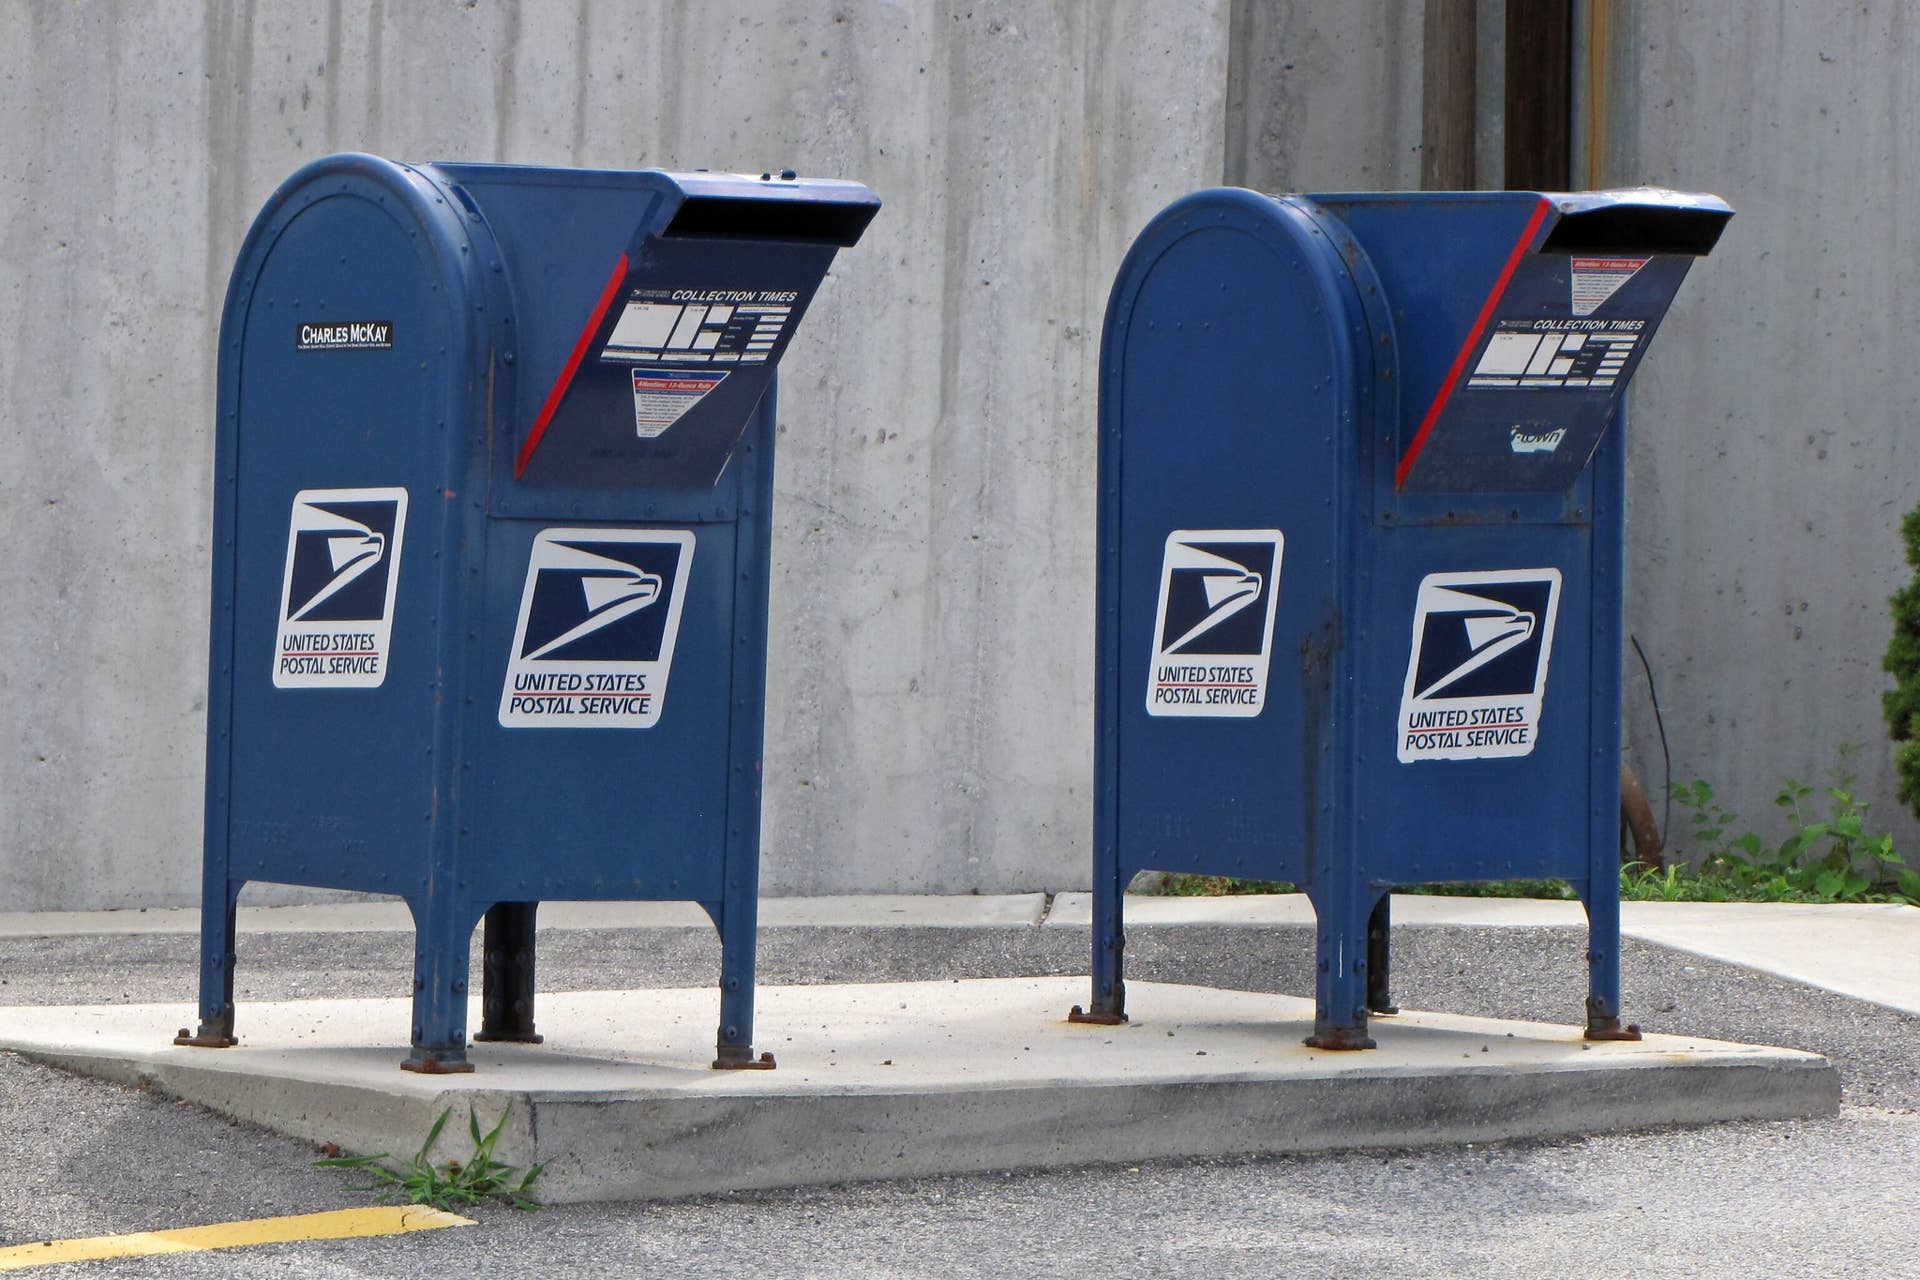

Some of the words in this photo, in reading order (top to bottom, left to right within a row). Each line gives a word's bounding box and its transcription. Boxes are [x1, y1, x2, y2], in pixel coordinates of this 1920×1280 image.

[671, 290, 757, 301] COLLECTION
[757, 291, 798, 302] TIMES
[1533, 320, 1608, 330] COLLECTION
[1607, 320, 1646, 331] TIMES
[283, 634, 330, 651] UNITED
[331, 634, 375, 651] STATES
[280, 657, 325, 675] POSTAL
[328, 657, 379, 674] SERVICE
[1157, 666, 1207, 683] UNITED
[1207, 666, 1254, 683] STATES
[514, 673, 582, 691] UNITED
[583, 674, 647, 691] STATES
[1155, 687, 1203, 704] POSTAL
[1204, 688, 1258, 704] SERVICE
[509, 697, 575, 714] POSTAL
[578, 697, 652, 714] SERVICE
[1408, 710, 1468, 729] UNITED
[1469, 706, 1524, 725] STATES
[1405, 732, 1463, 751] POSTAL
[1465, 728, 1529, 747] SERVICE
